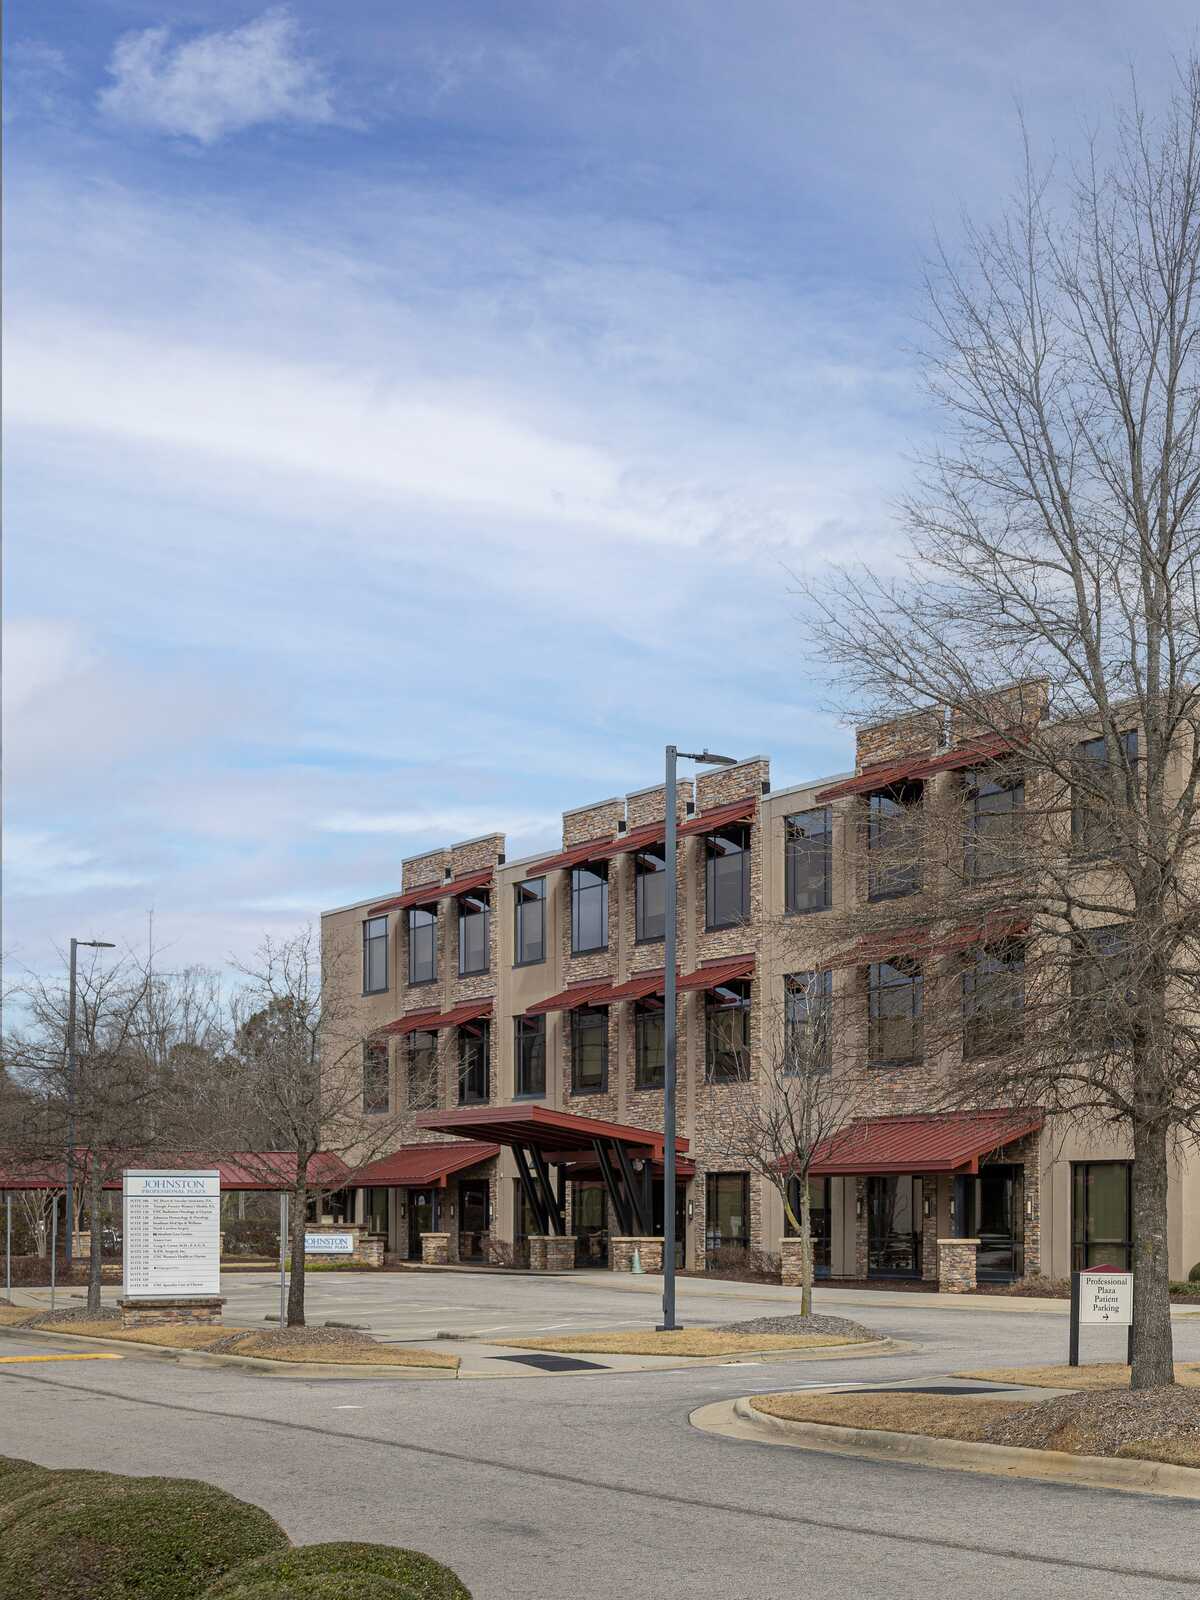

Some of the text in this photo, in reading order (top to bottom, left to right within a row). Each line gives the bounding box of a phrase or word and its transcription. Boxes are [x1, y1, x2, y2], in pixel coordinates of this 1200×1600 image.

[145, 1179, 205, 1189] JOHNSTON
[1086, 1277, 1127, 1285] Professional
[1097, 1286, 1116, 1294] Plaza
[1094, 1295, 1119, 1303] Patient
[1093, 1304, 1119, 1312] Parking
